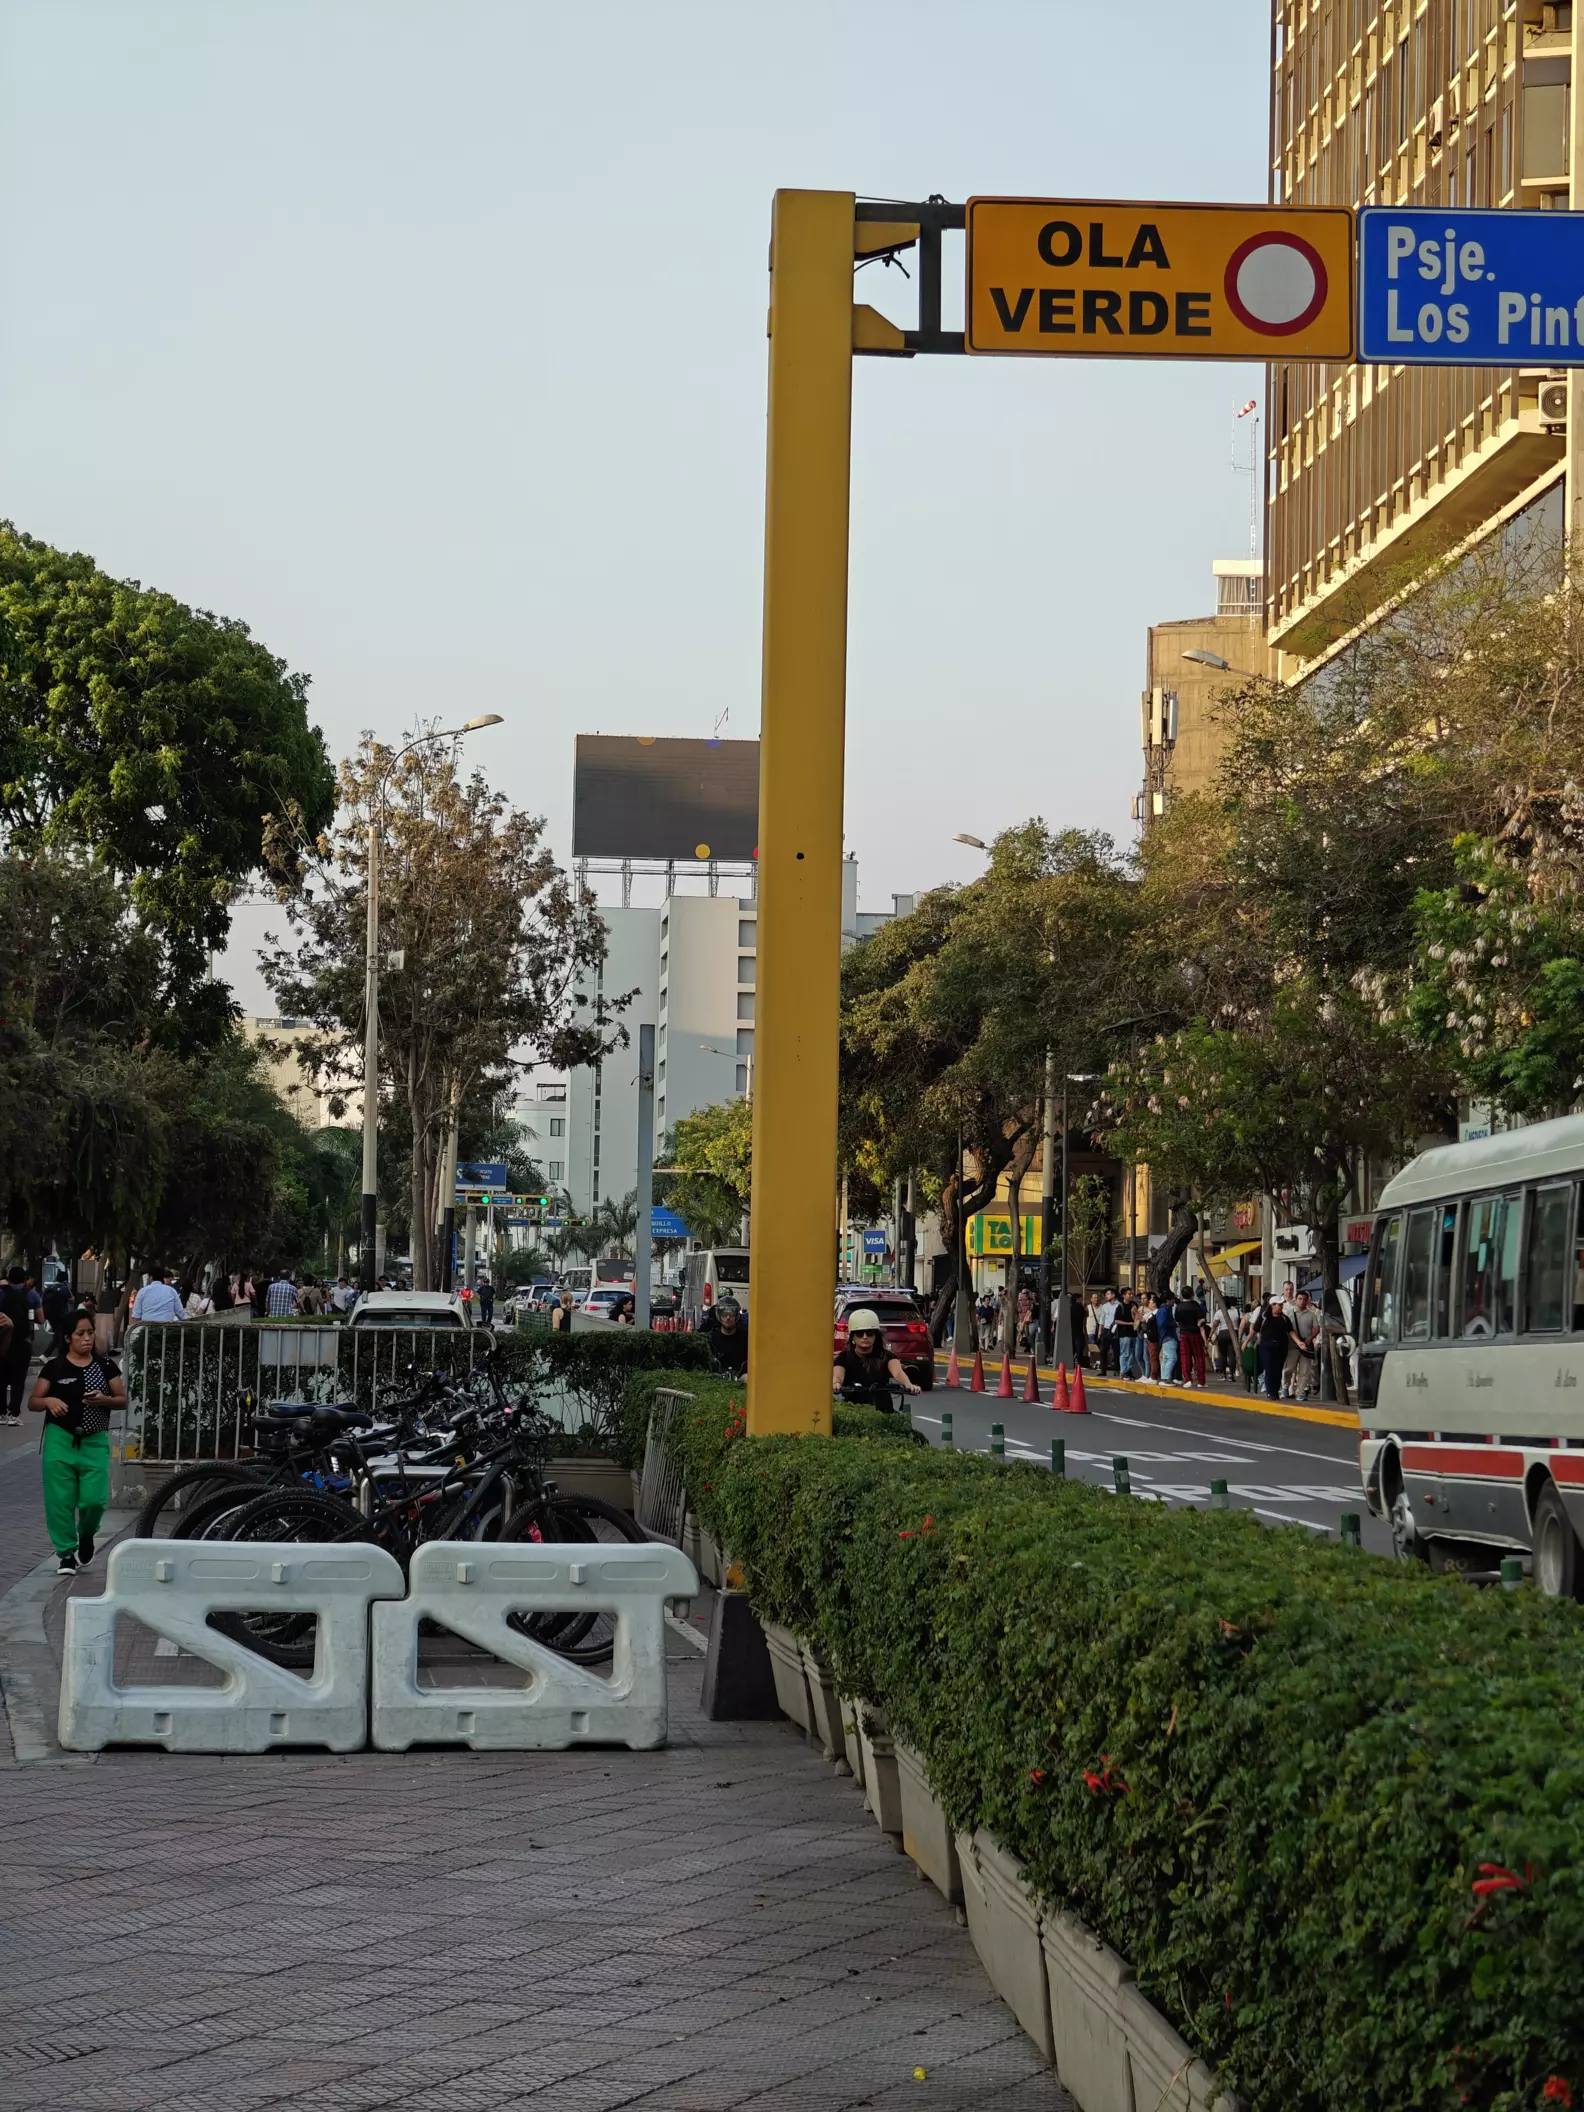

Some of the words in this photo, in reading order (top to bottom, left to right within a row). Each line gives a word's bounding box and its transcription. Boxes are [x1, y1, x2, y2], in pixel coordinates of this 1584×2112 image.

[1037, 220, 1171, 270] OLA
[1387, 225, 1496, 296] Psje.
[988, 287, 1212, 337] VERDE
[1387, 289, 1470, 344] Los
[865, 1237, 885, 1245] VISA
[988, 1221, 1017, 1234] TA
[990, 1235, 1017, 1248] LO
